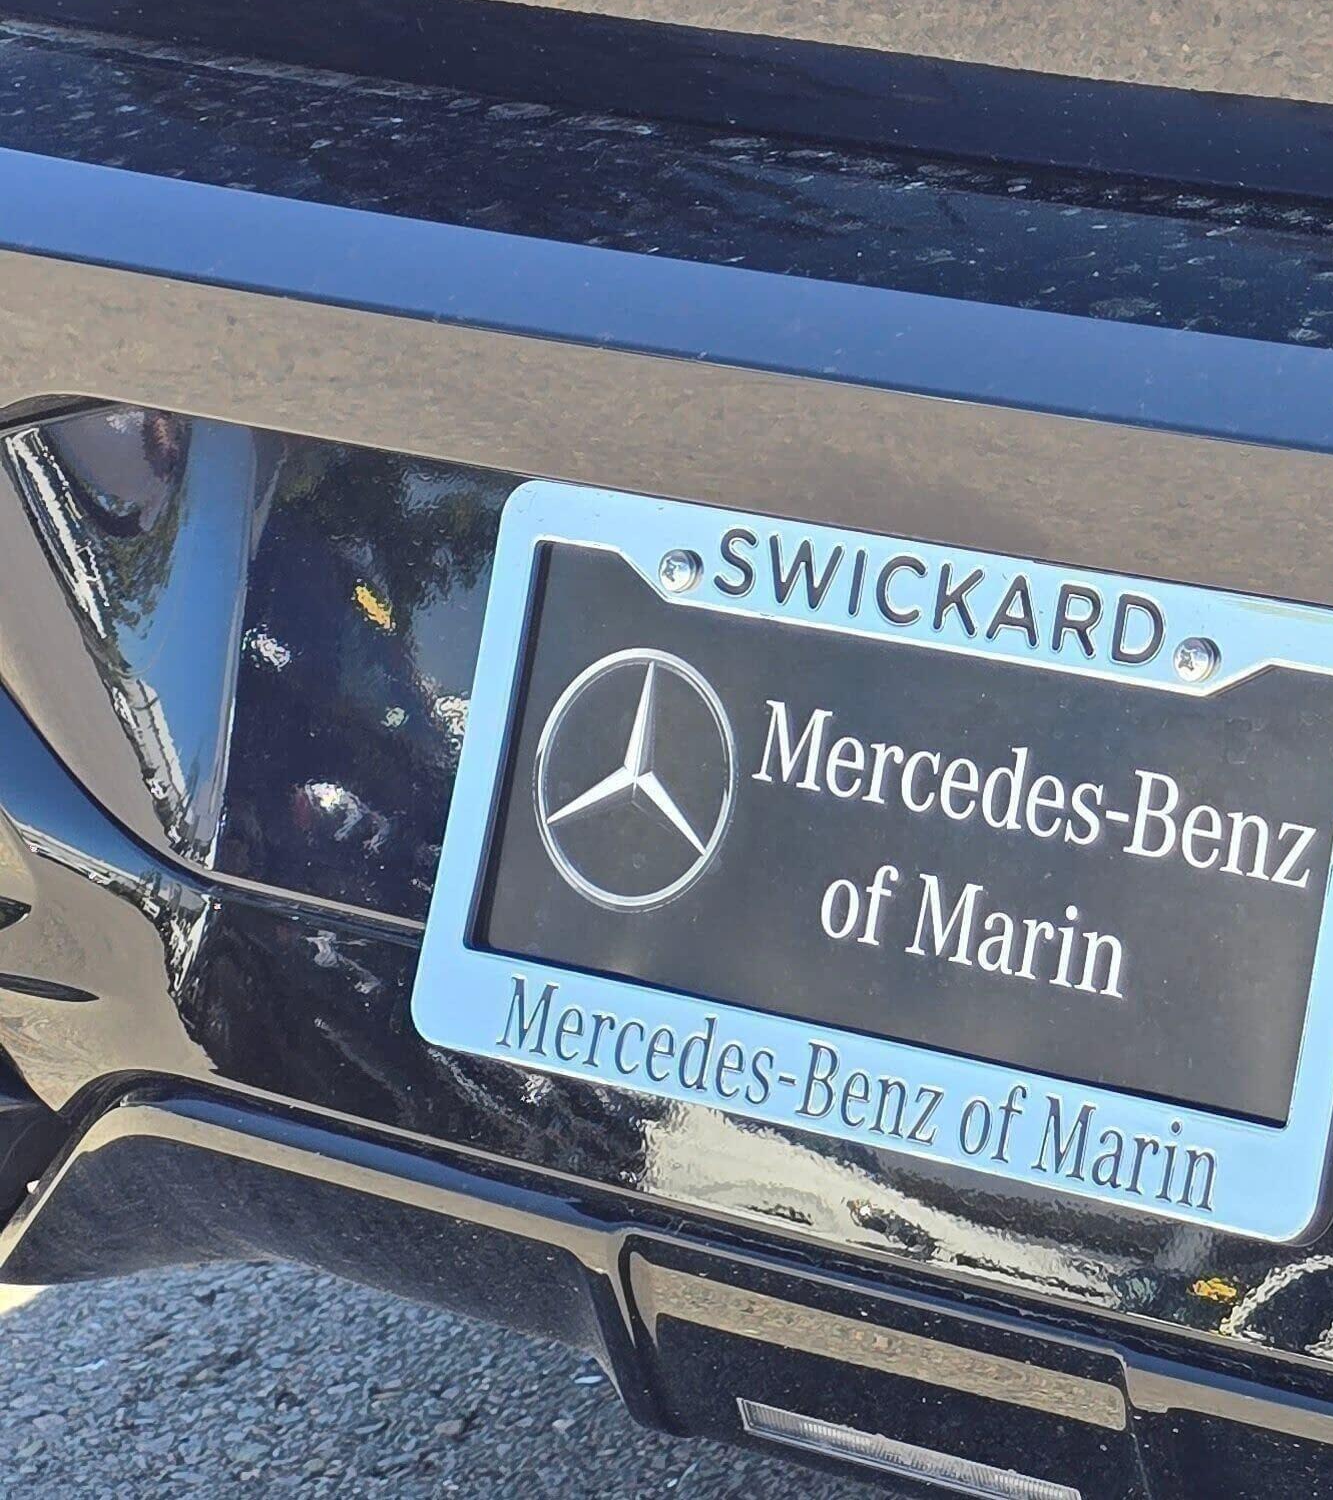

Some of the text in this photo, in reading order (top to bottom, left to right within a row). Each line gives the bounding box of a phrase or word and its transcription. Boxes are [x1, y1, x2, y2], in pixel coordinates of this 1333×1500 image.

[713, 528, 1166, 667] SWICKARD
[752, 700, 1317, 889] Mercedes-Benz
[820, 866, 1126, 999] of Marin
[496, 974, 1219, 1213] Mercedes-Benz of Marin
